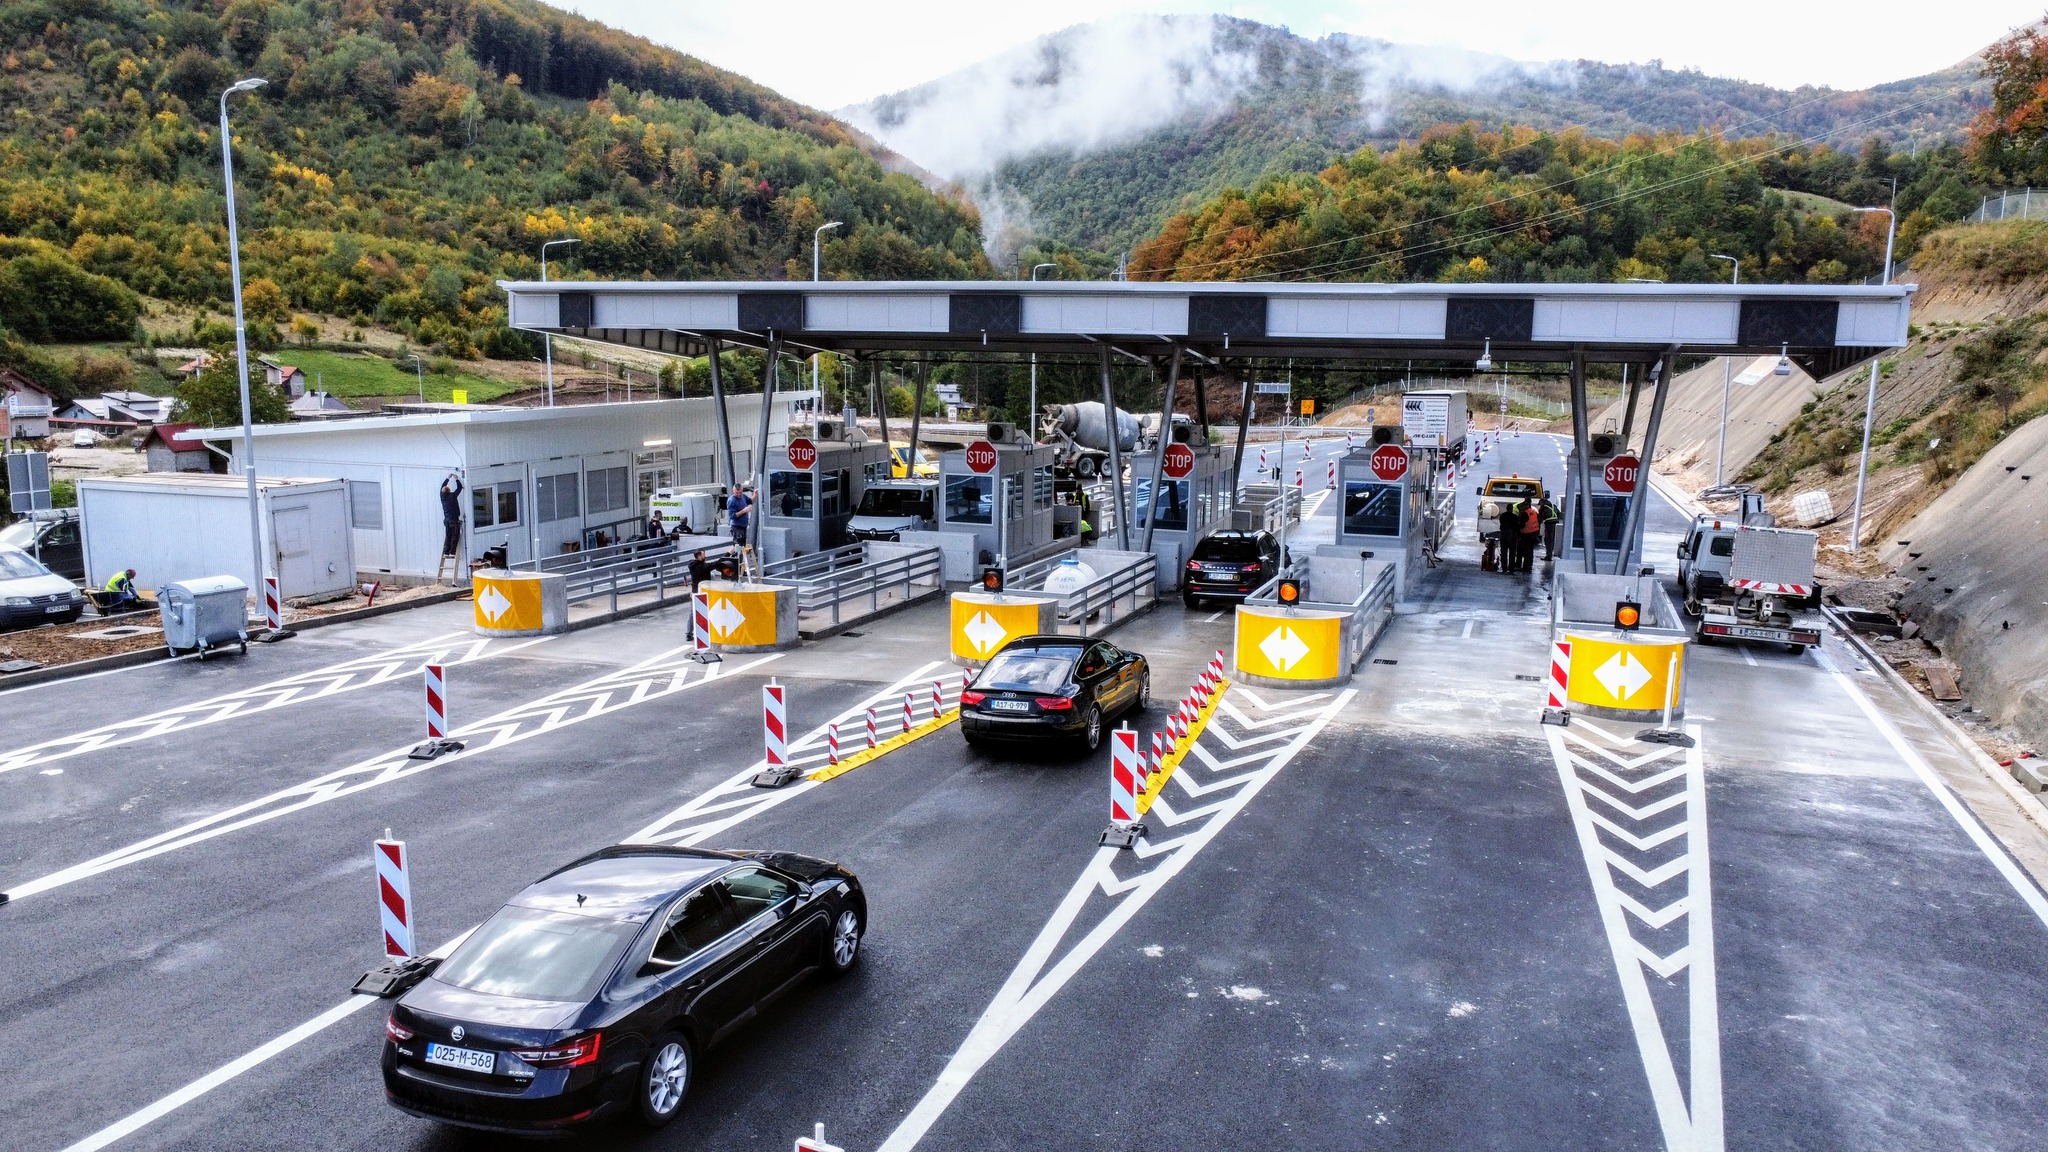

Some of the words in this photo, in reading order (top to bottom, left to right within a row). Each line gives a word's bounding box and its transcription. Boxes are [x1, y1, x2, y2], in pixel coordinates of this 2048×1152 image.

[789, 448, 814, 460] STOP
[967, 451, 994, 464] STOP
[1163, 454, 1192, 468] STOP
[1373, 456, 1406, 470] STOP
[434, 1046, 492, 1068] 025-M-568
